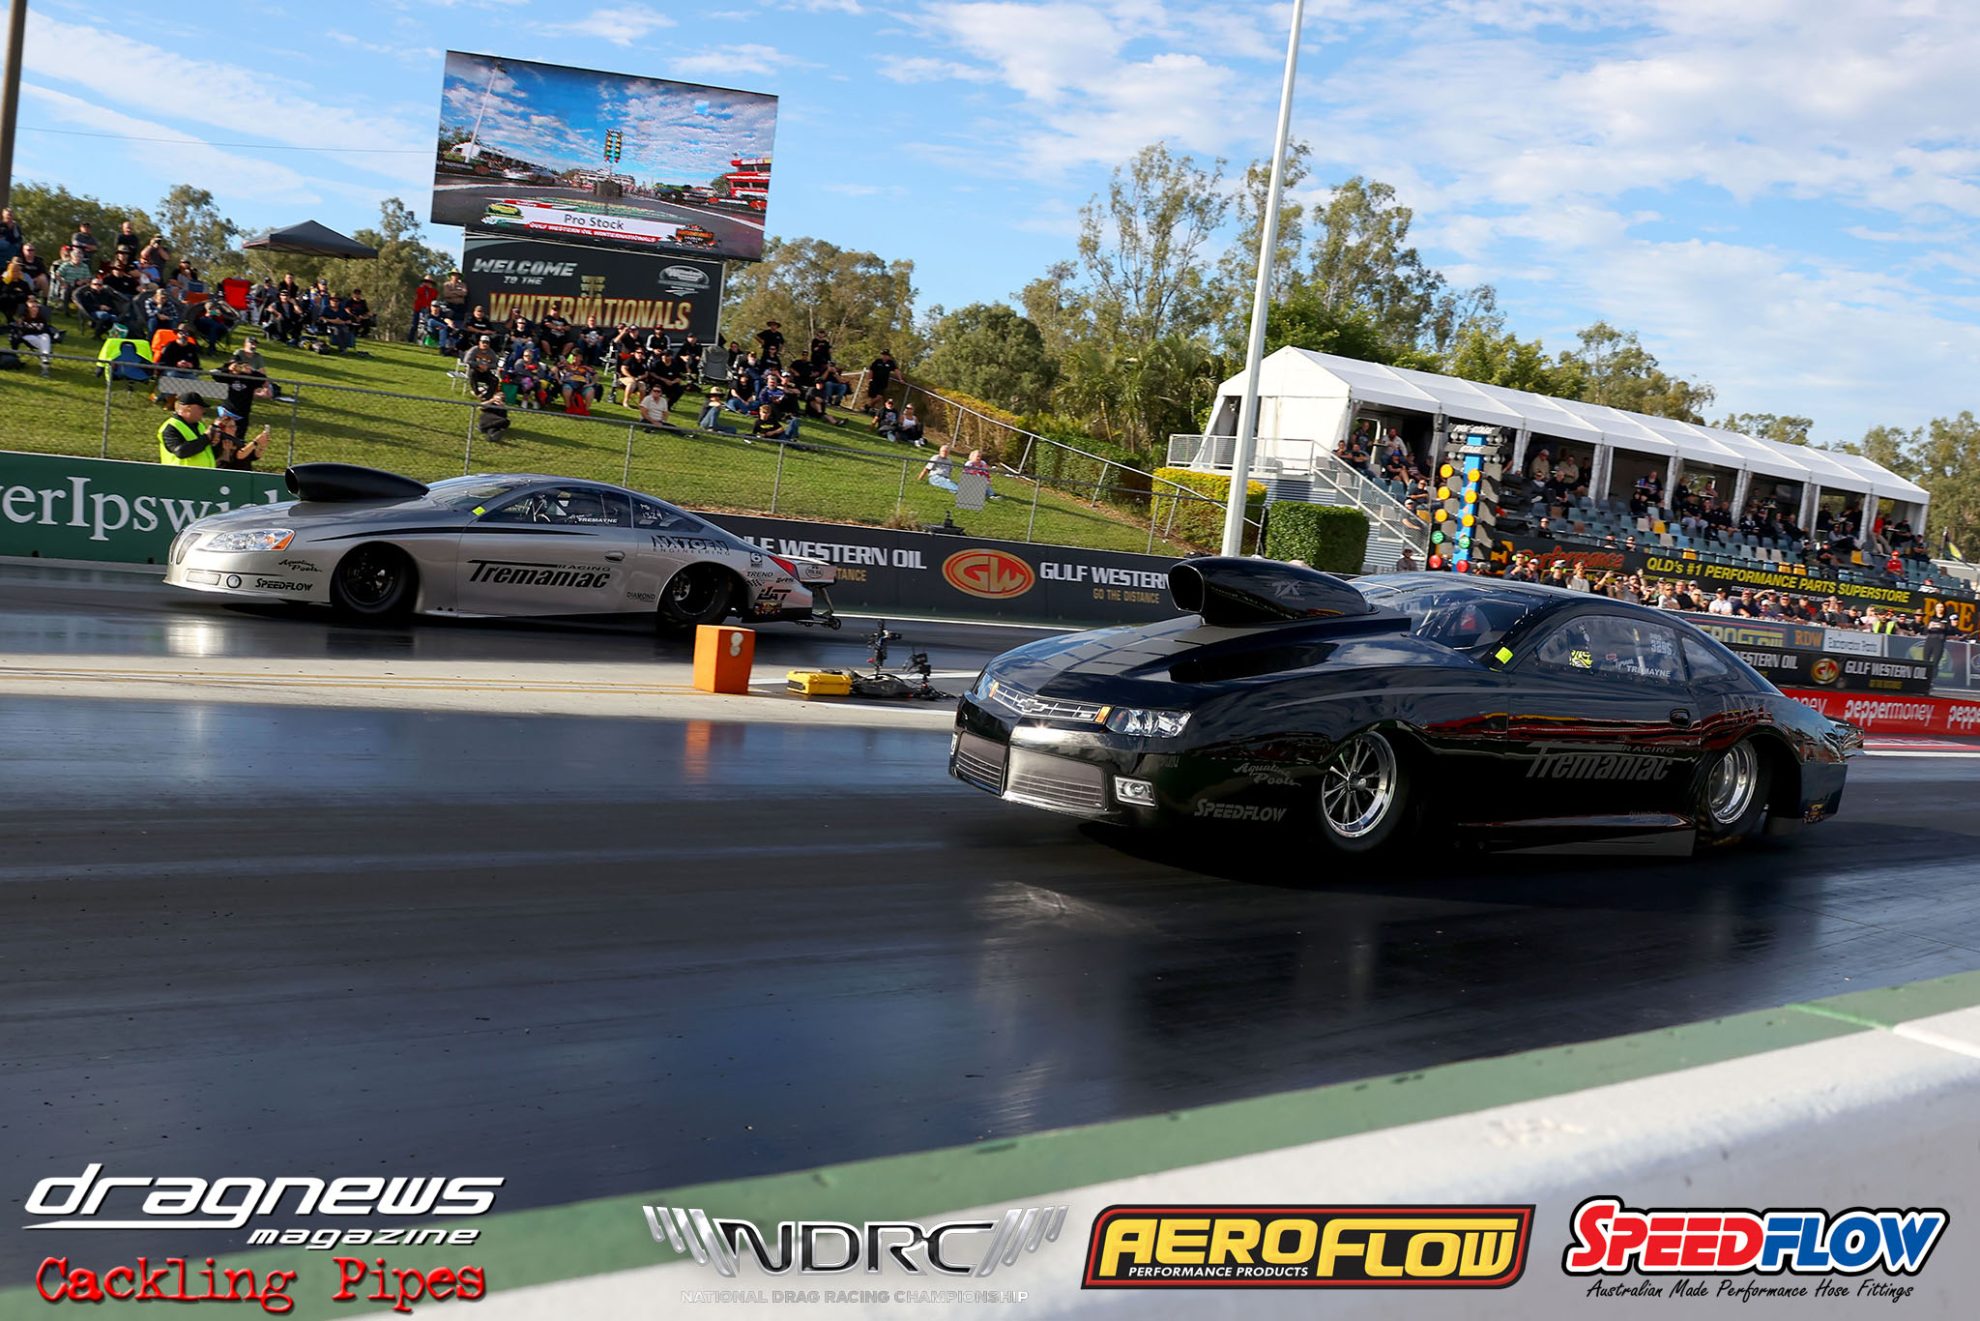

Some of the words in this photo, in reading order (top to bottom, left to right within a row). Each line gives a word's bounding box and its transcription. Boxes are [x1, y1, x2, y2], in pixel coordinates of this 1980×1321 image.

[564, 213, 586, 227] Pro
[589, 216, 624, 230] Stock
[471, 258, 578, 277] WELCOME
[503, 276, 517, 284] TO
[520, 276, 543, 286] THE
[750, 552, 762, 563] 6
[779, 541, 887, 566] WESTERN
[893, 548, 927, 570] OIL
[467, 559, 611, 589] Tremaniac
[558, 564, 610, 572] RACING
[747, 570, 774, 578] TREND
[1039, 562, 1088, 582] GULF
[255, 577, 313, 592] SPEEDFLOW
[1647, 557, 1685, 575] QLD's
[1687, 561, 1702, 577] #1
[1705, 565, 1796, 590] PERFORMANCE
[1799, 577, 1836, 595] PARTS
[1838, 581, 1911, 604] SUPERSTORE
[626, 591, 656, 600] DIAMOND
[1093, 588, 1104, 599] GO
[1107, 589, 1121, 601] THE
[1123, 591, 1160, 604] DISTANCE
[1781, 655, 1799, 670] OIL
[1844, 660, 1871, 675] GULF
[1871, 663, 1913, 679] WESTERN
[1913, 667, 1929, 680] OIL
[1844, 699, 1935, 730] peppermoney
[1621, 744, 1676, 754] RACING
[1526, 741, 1673, 781] Tremaniac
[1194, 798, 1287, 822] SPEEDFLOW
